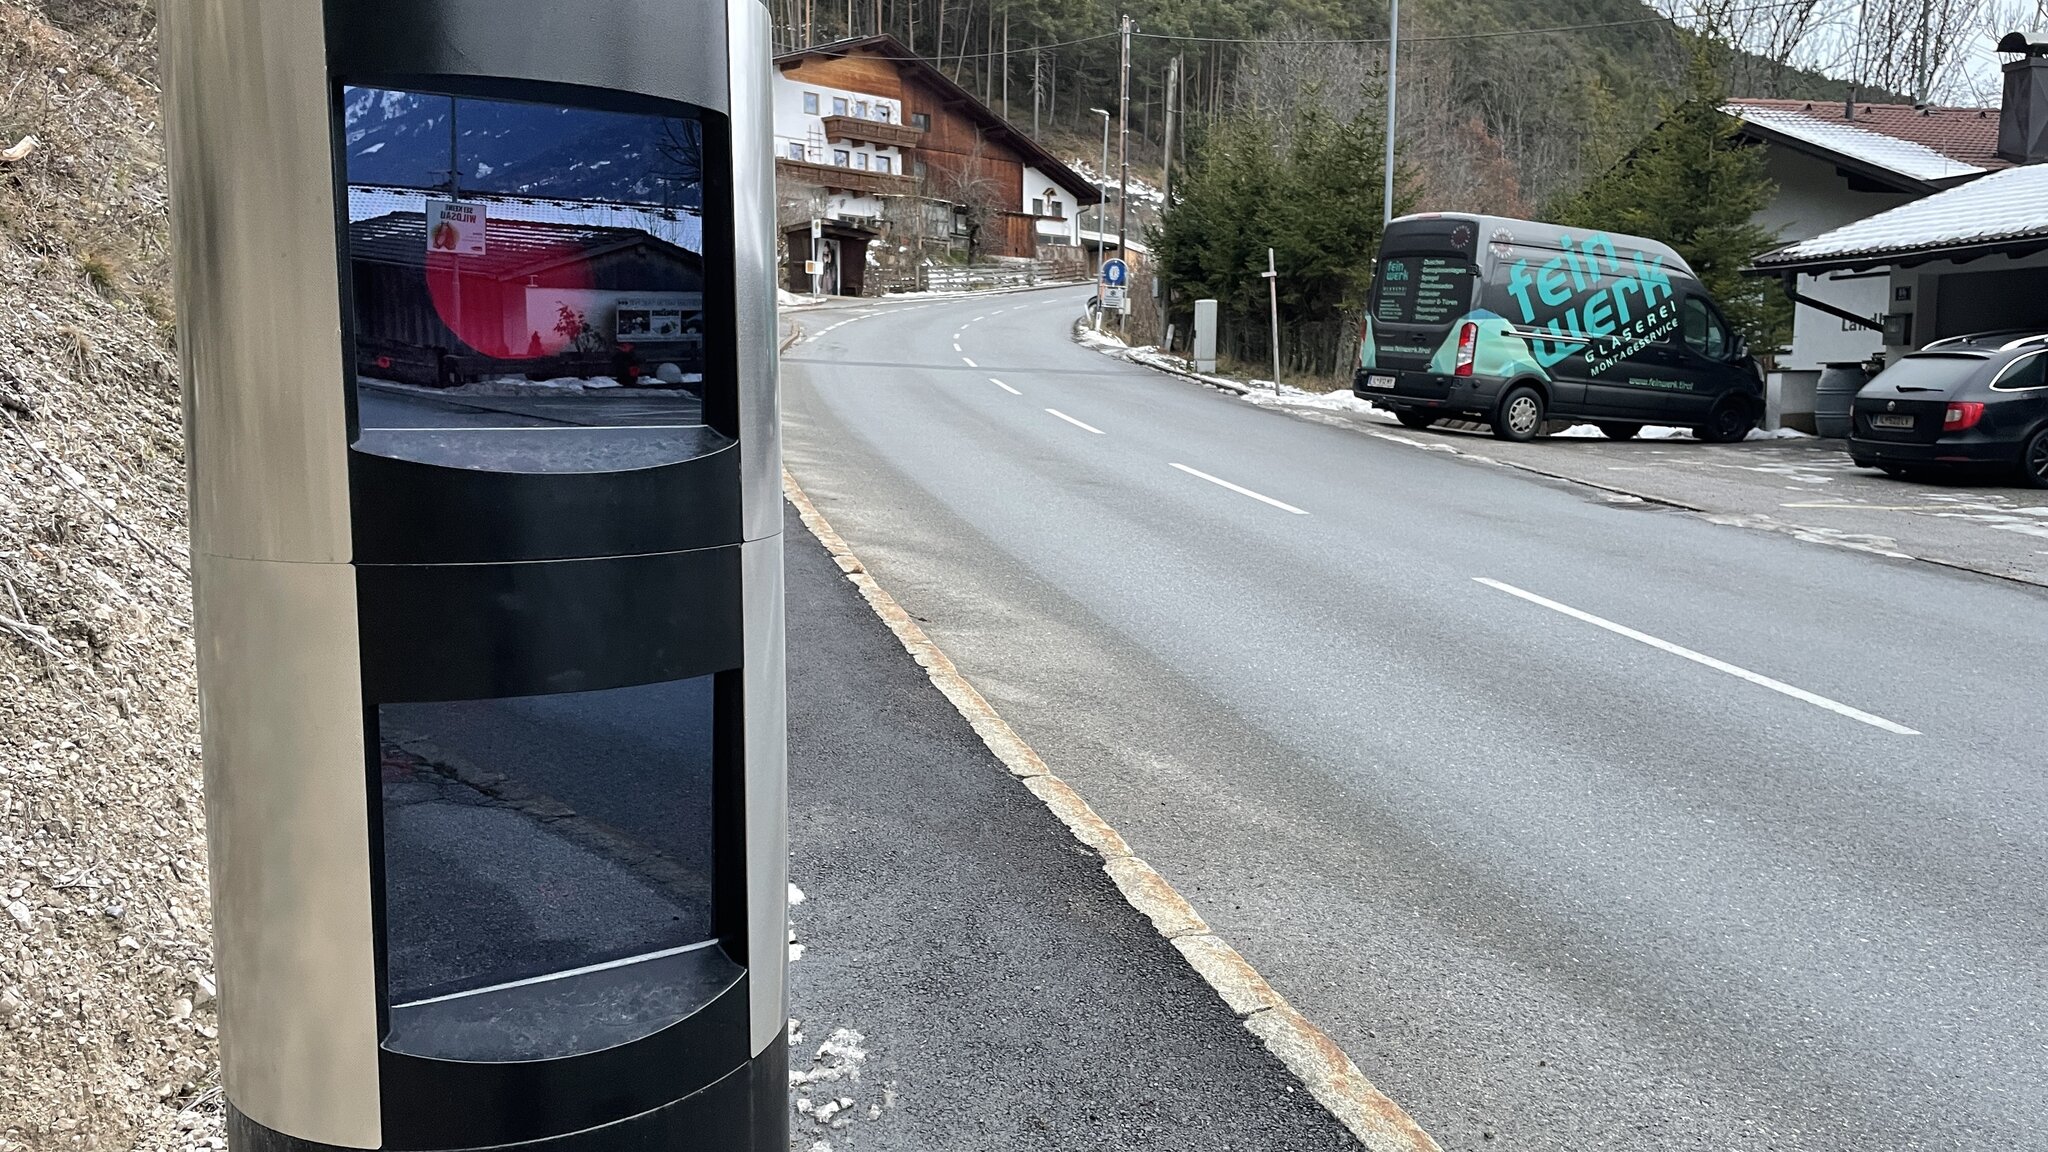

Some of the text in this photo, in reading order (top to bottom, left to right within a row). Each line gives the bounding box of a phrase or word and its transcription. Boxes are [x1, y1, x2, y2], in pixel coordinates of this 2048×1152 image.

[1507, 231, 1620, 324] fein
[1532, 251, 1673, 368] werk
[1585, 300, 1676, 363] GLASEREI
[1590, 318, 1679, 376] MONTAGESERVICE
